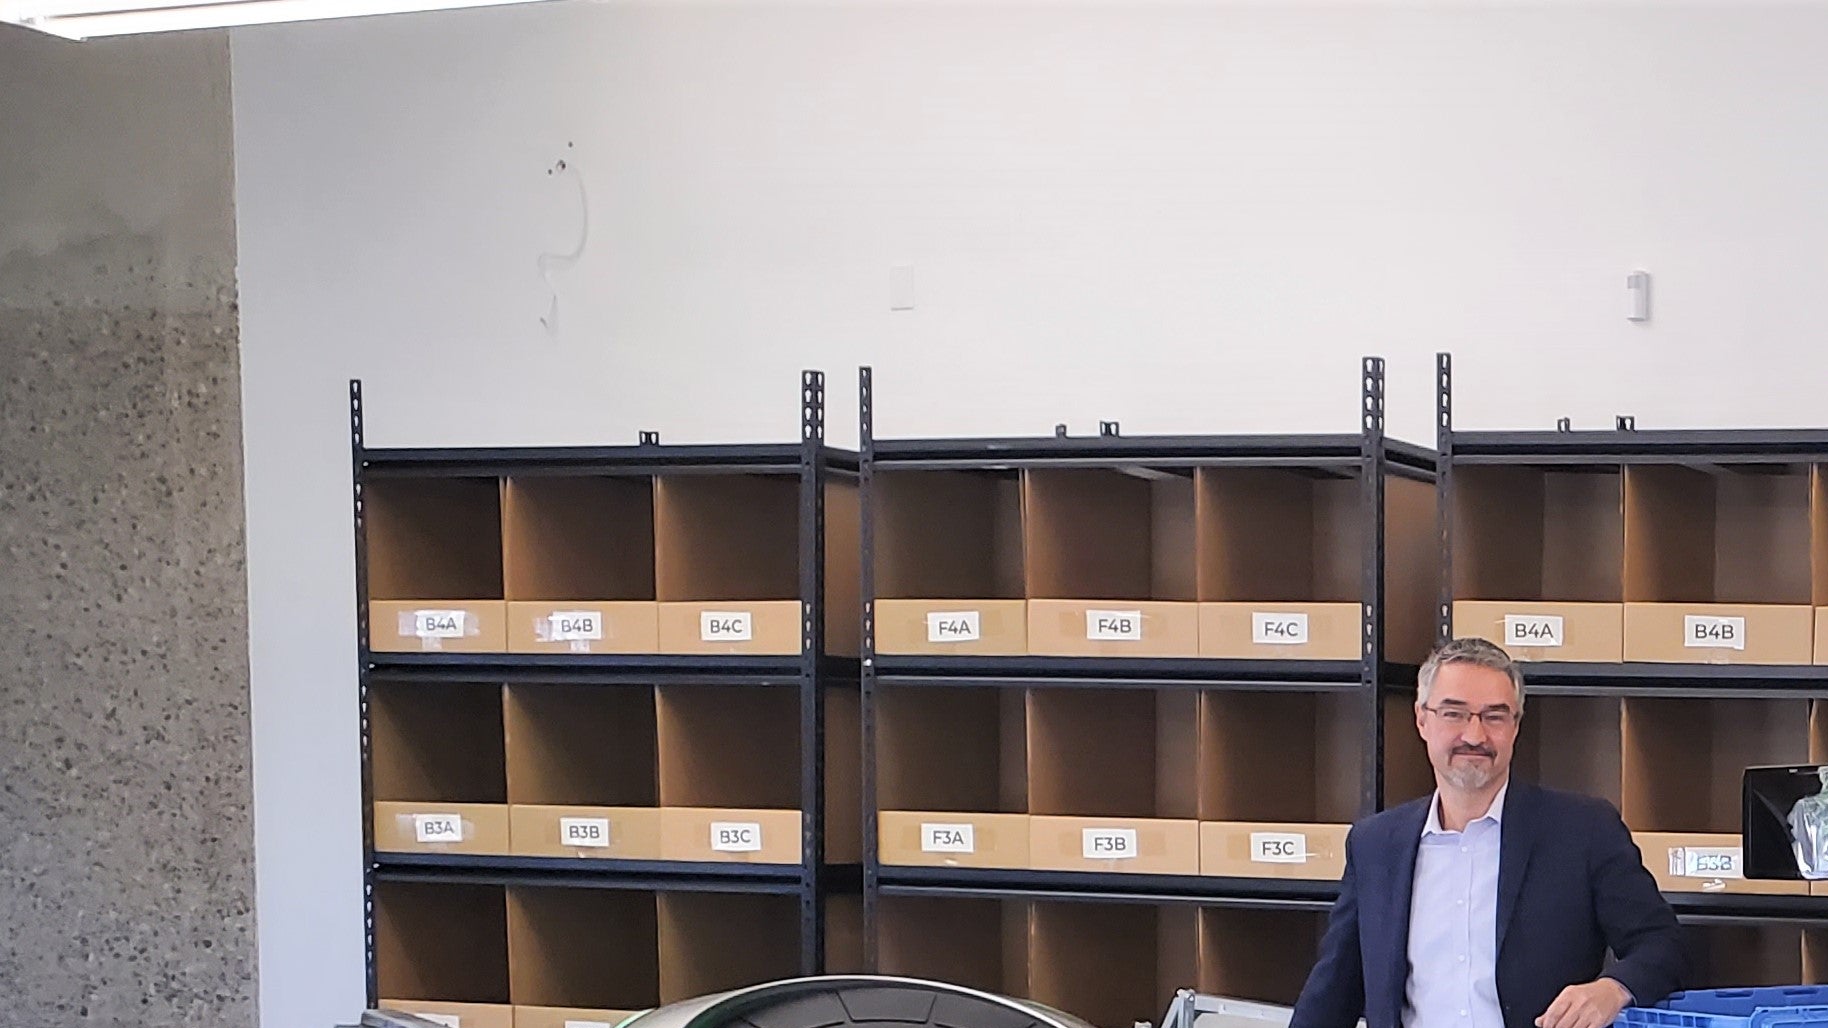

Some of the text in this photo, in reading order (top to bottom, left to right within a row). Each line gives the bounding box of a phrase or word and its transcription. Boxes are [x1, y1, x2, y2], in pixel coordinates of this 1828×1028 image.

[426, 617, 457, 631] B4A
[562, 619, 593, 632] B4B
[711, 620, 742, 633] B4C
[939, 620, 971, 635] F4A
[1099, 619, 1131, 633] F4B
[1265, 622, 1298, 636] F4C
[1515, 623, 1553, 638] B4A
[1696, 624, 1734, 639] B4B
[425, 821, 454, 834] B3A
[569, 826, 599, 838] B3B
[720, 830, 751, 843] B3C
[933, 831, 964, 844] F3A
[1095, 837, 1126, 851] F3B
[1263, 841, 1294, 855] F3C
